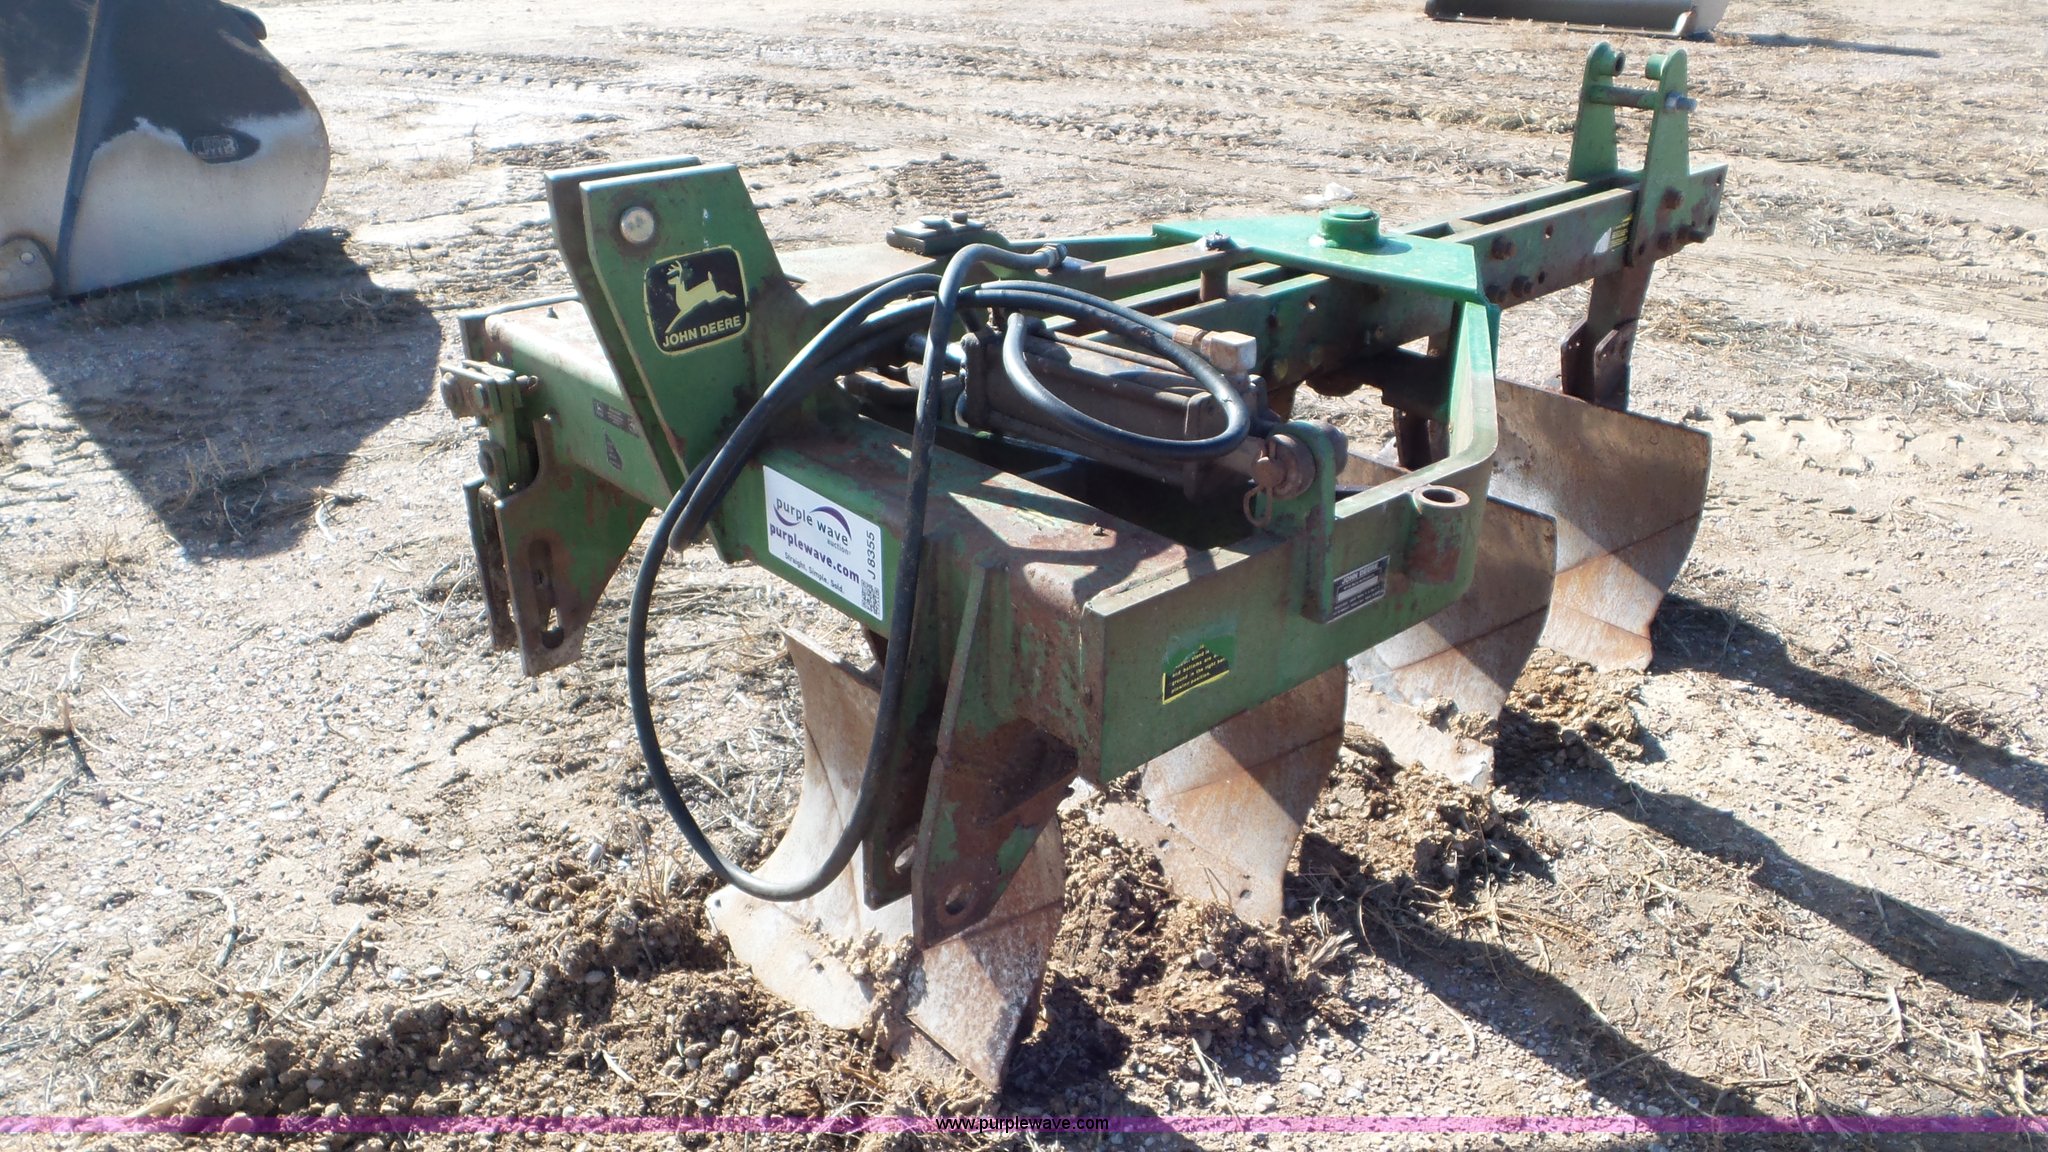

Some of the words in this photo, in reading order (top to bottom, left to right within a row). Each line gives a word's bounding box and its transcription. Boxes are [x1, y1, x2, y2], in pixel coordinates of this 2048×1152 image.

[662, 328, 698, 347] JOHN
[700, 315, 742, 336] DEERE
[776, 498, 813, 527] purple
[816, 519, 849, 547] wave
[769, 523, 860, 584] purplewave.com
[866, 530, 876, 569] 8355
[867, 569, 876, 580] J
